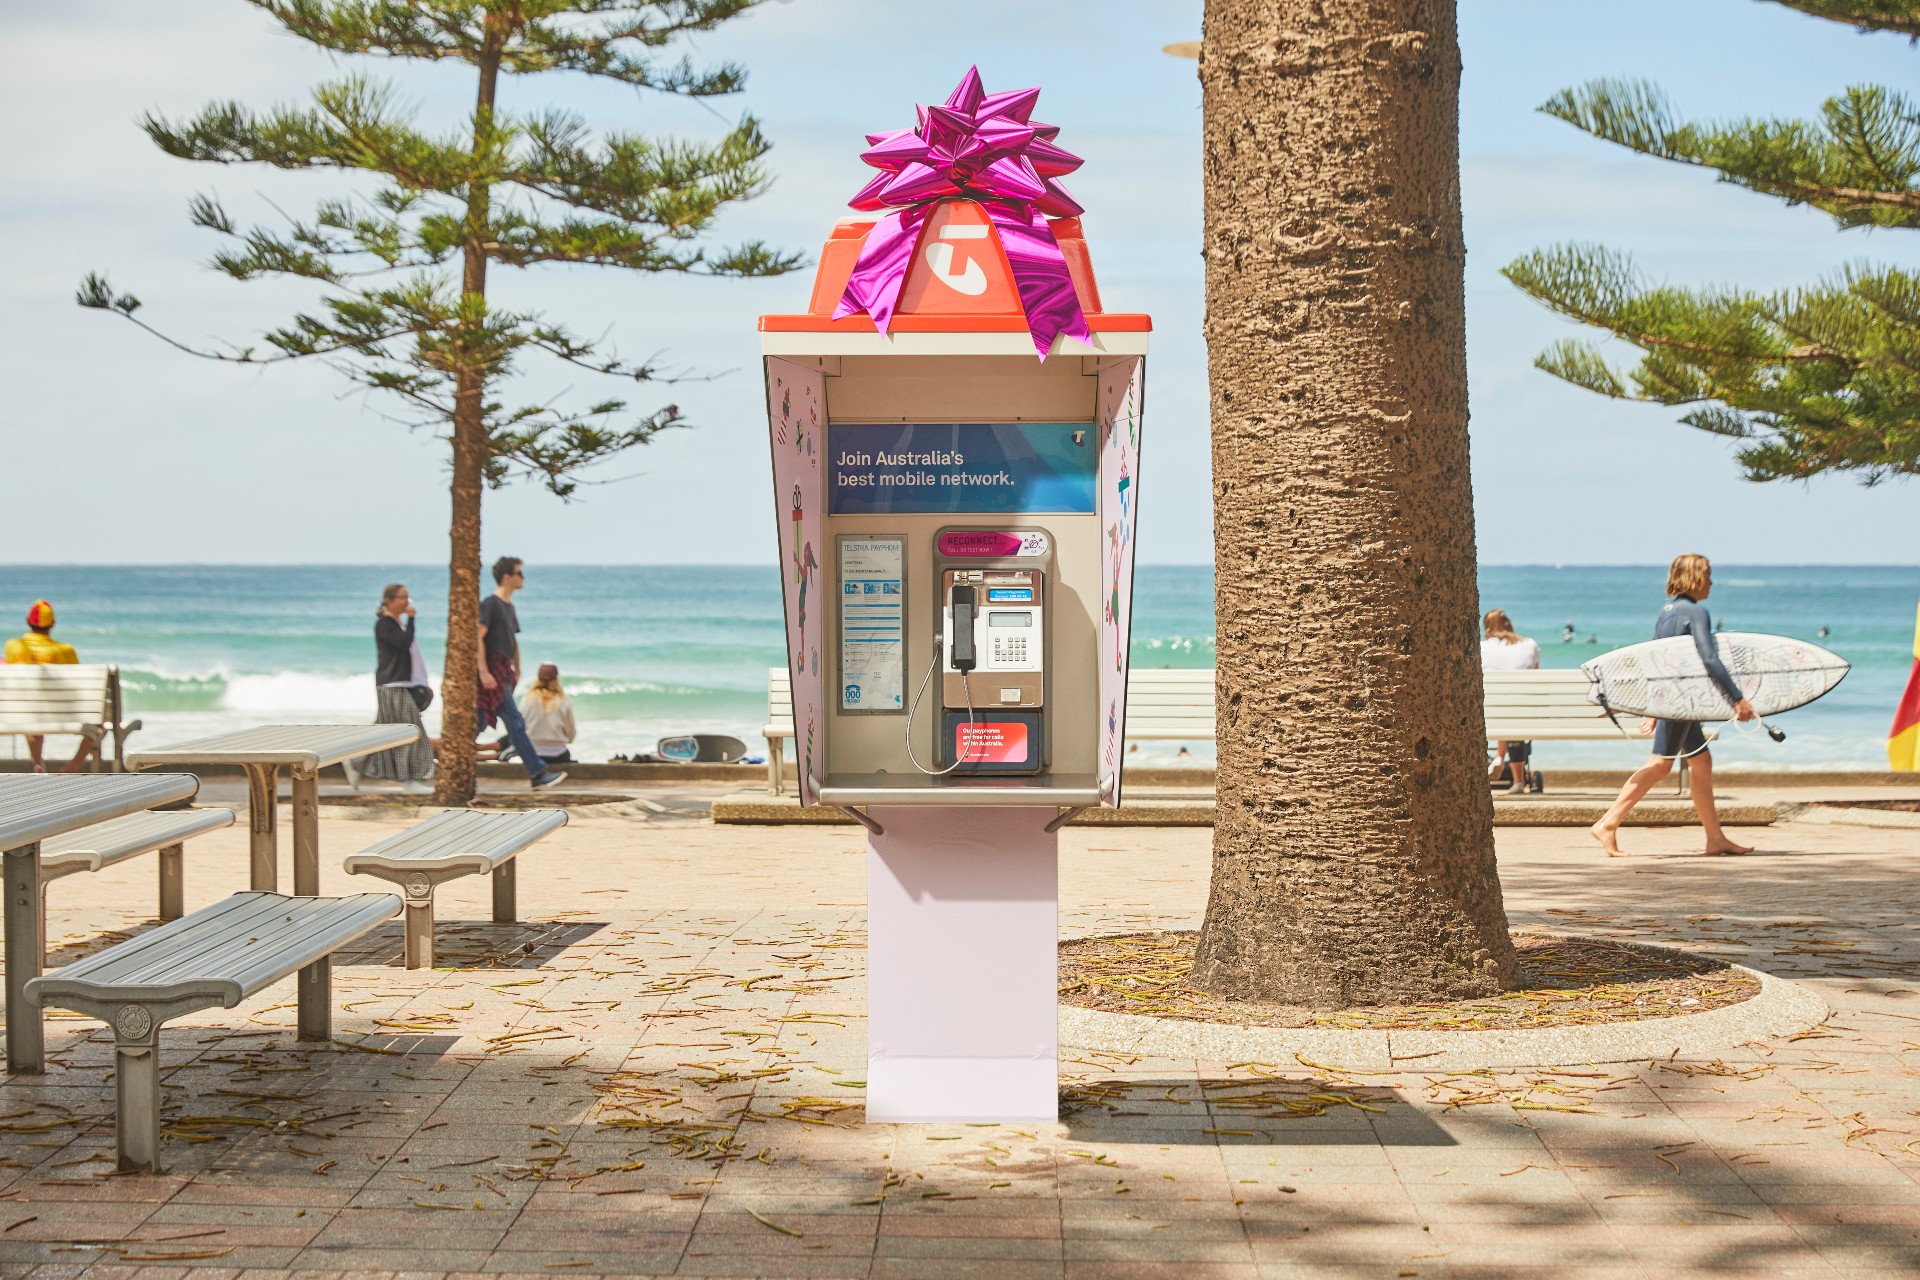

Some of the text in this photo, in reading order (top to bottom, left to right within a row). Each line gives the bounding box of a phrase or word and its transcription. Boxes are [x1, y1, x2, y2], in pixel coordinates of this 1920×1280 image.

[837, 450, 964, 466] Join Australia's
[837, 471, 1015, 486] best mobile network.
[844, 544, 900, 552] TELSTRA PAYPHONE
